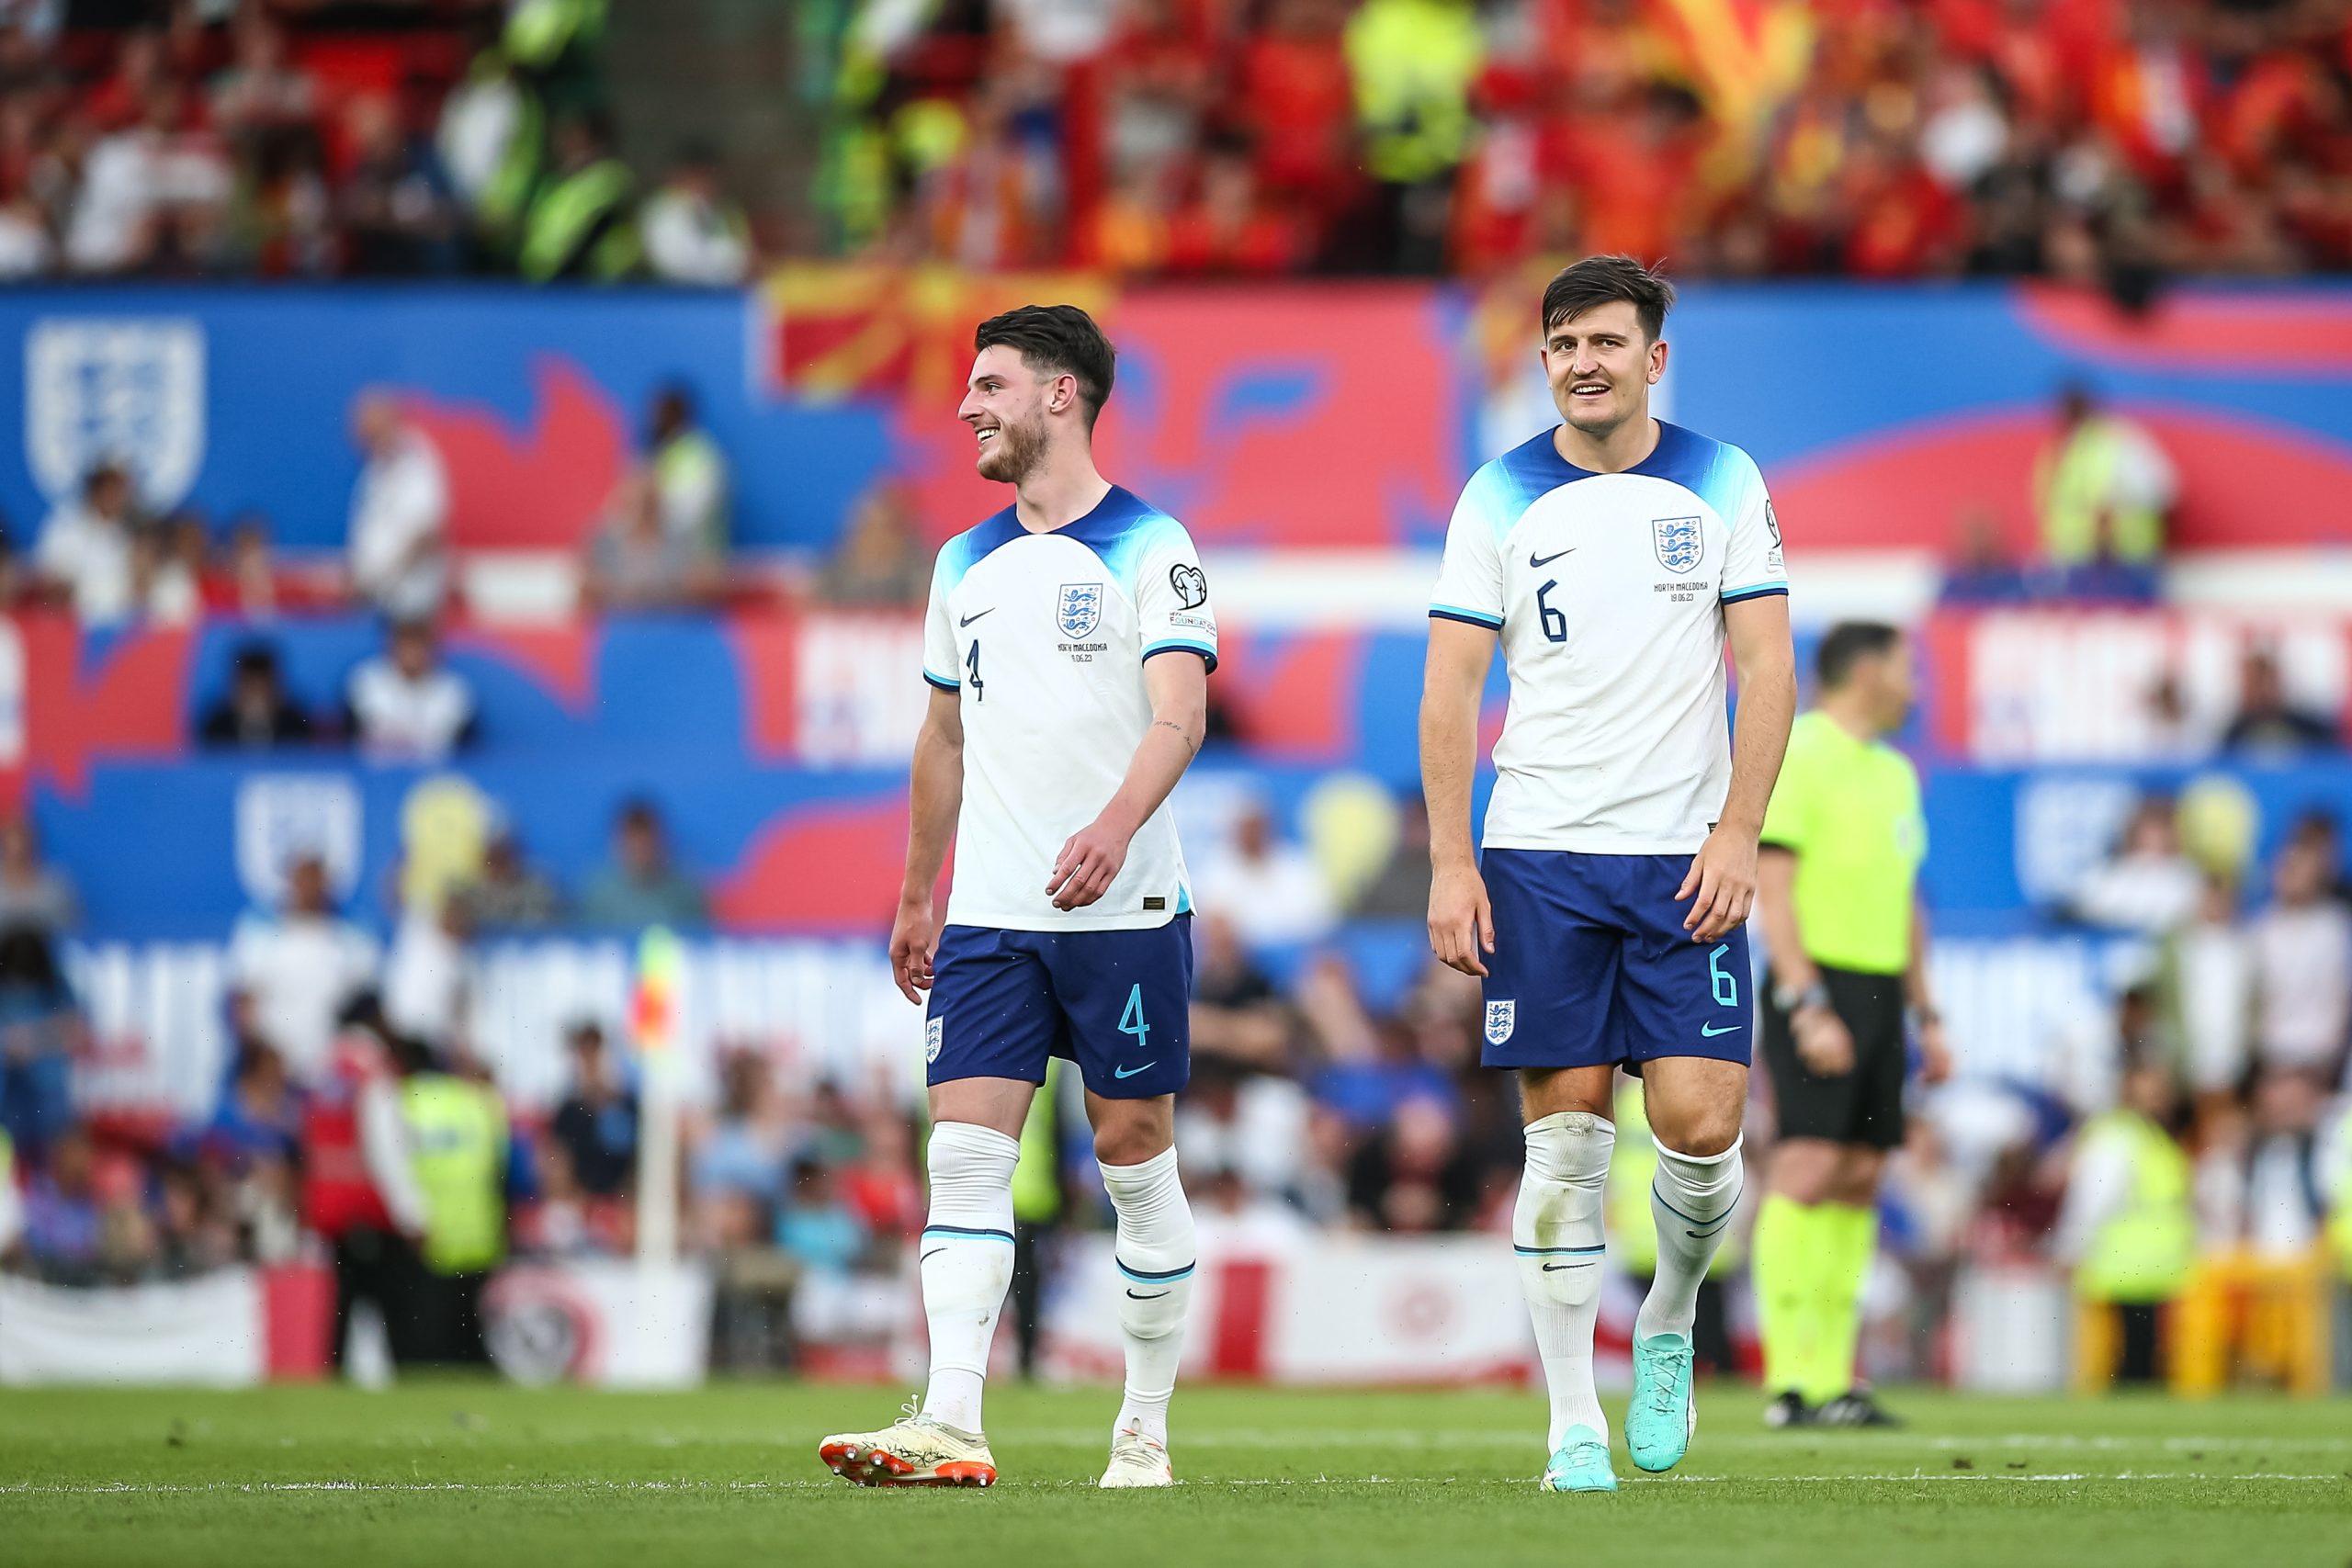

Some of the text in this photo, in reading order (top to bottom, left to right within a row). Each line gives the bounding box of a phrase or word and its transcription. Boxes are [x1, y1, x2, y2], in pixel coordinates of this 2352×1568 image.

[1537, 579, 1566, 642] 6
[1654, 583, 1674, 592] NORTH
[1671, 593, 1694, 602] 19.06.23
[967, 639, 983, 702] 4
[1710, 943, 1738, 1007] 6
[1117, 983, 1150, 1046] 4
